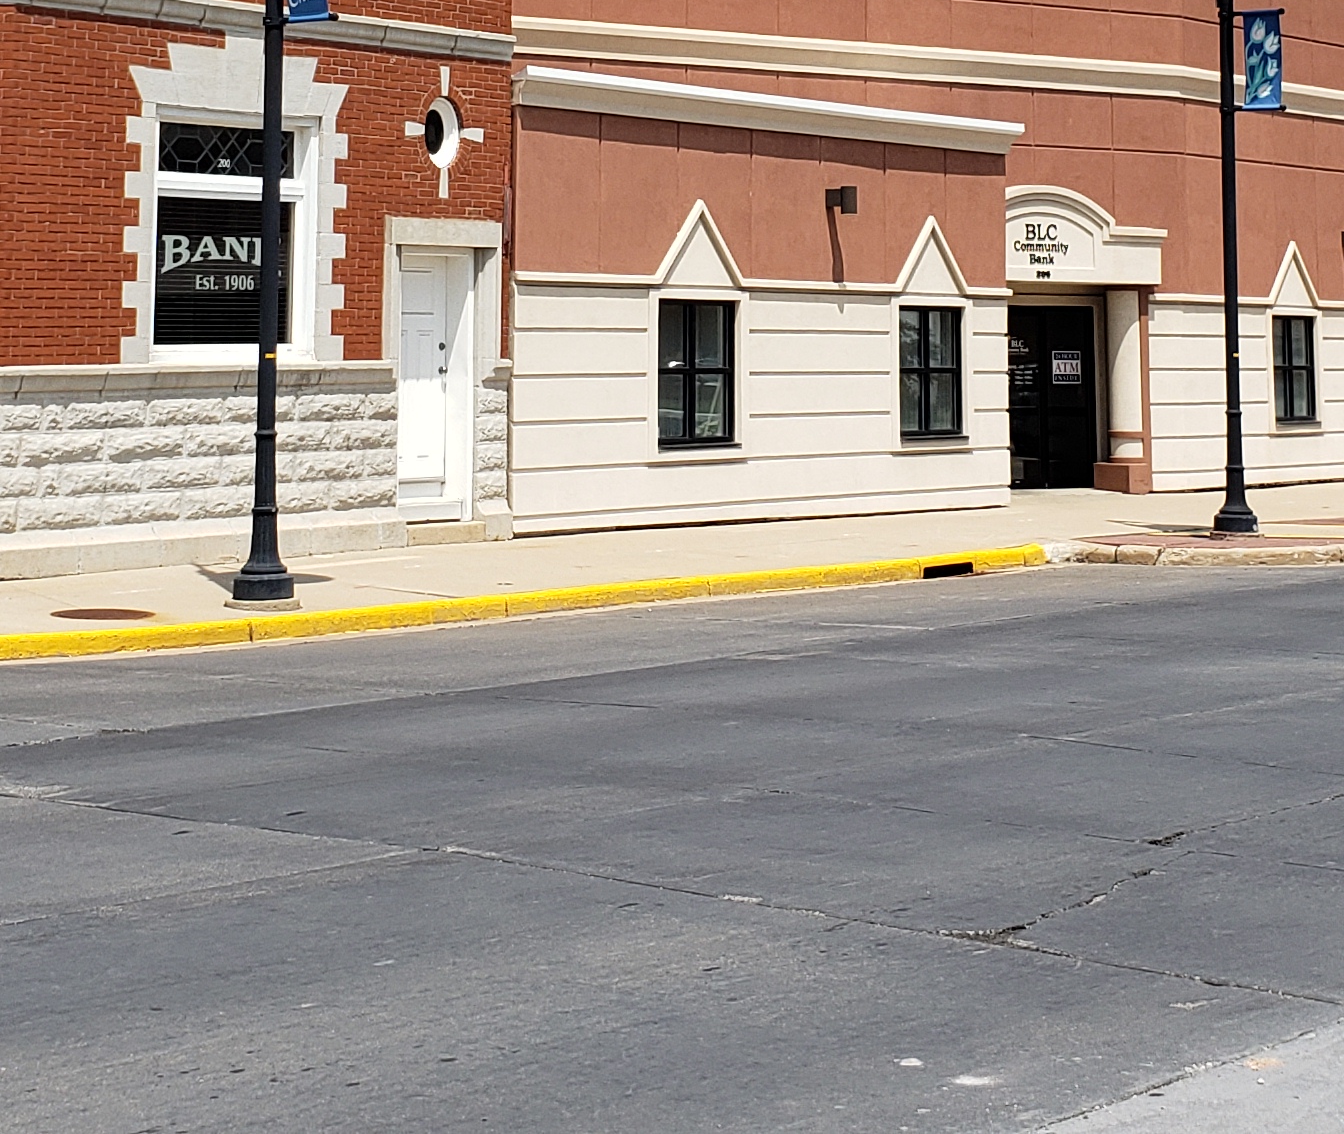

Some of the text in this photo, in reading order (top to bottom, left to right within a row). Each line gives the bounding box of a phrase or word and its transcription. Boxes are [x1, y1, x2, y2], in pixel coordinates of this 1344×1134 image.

[217, 158, 231, 168] 200
[1025, 223, 1058, 241] BLC
[1013, 240, 1069, 256] Community
[1029, 253, 1055, 265] Bank
[195, 275, 254, 291] Est. 1906
[1054, 361, 1079, 374] ATM
